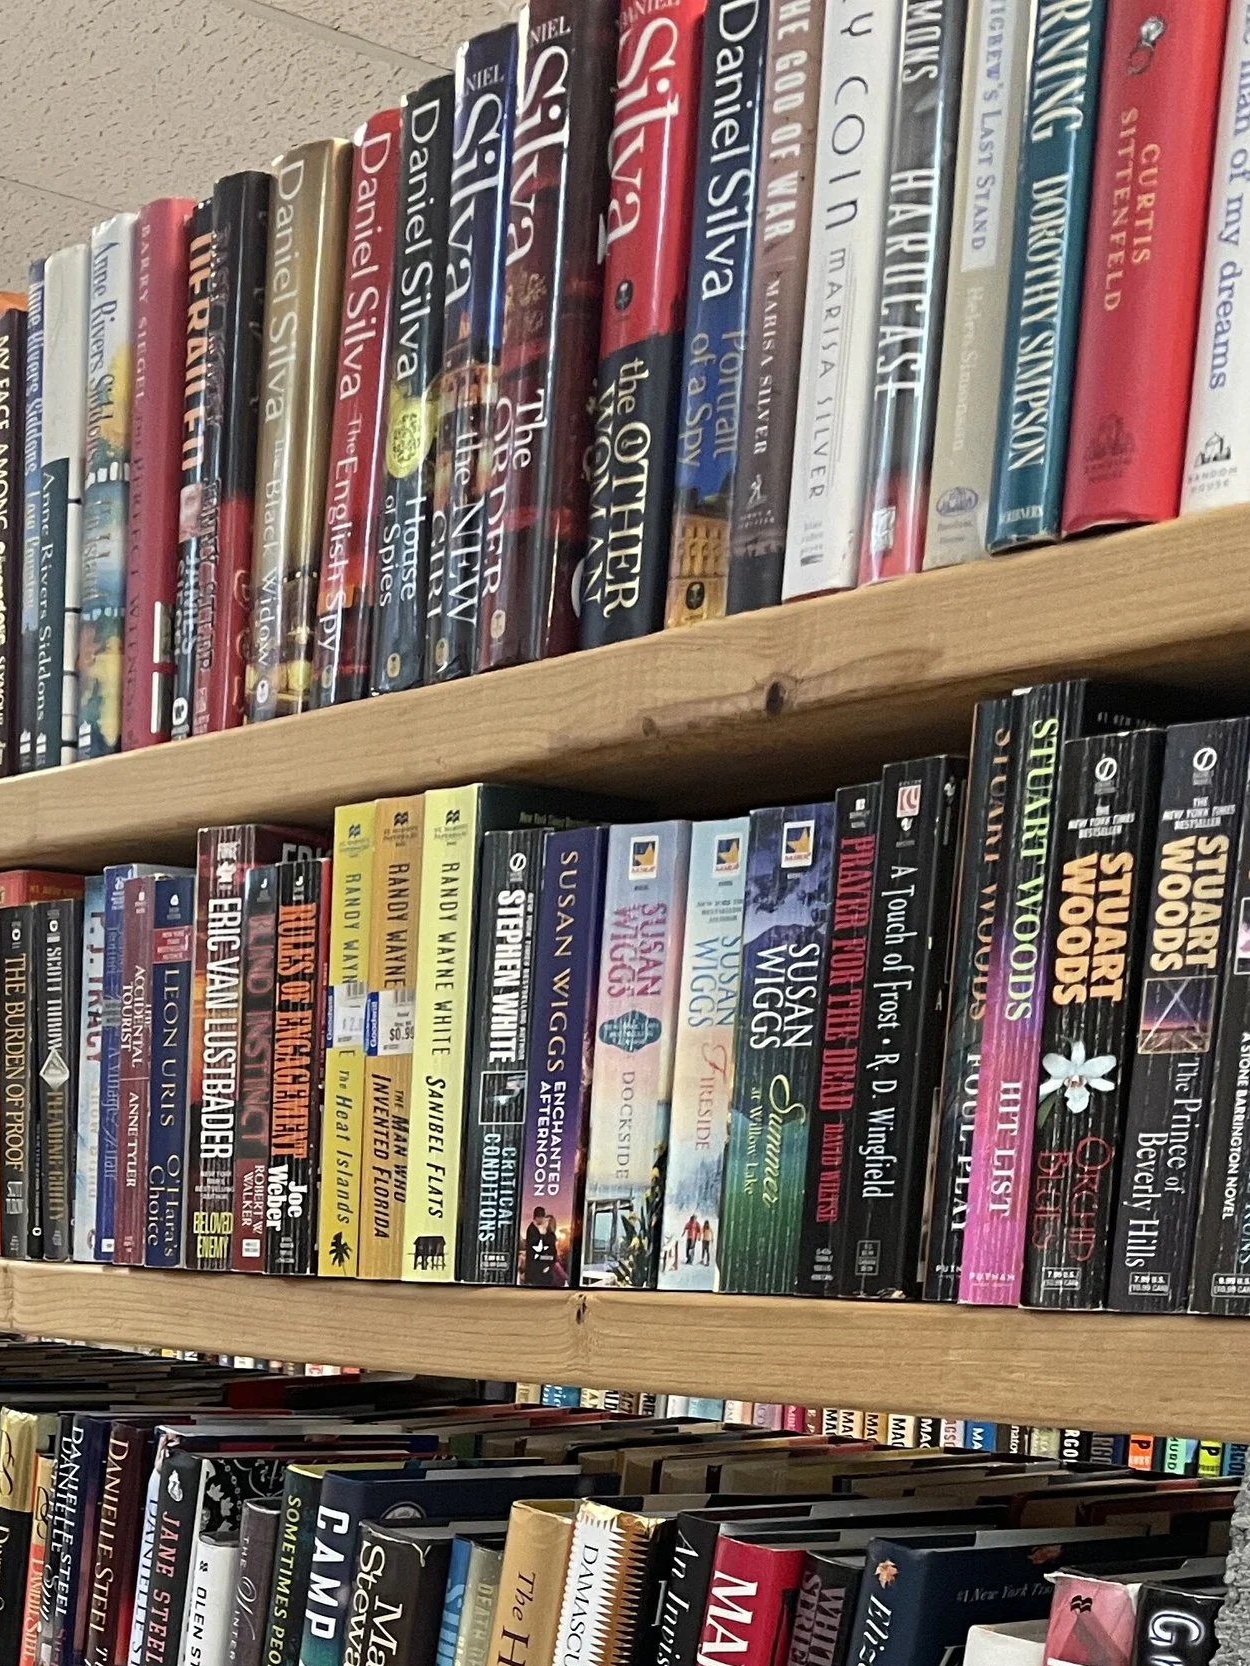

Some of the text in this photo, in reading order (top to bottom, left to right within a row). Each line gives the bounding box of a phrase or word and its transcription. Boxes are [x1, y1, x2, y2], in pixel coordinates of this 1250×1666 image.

[607, 16, 682, 245] Silva
[700, 0, 758, 301] Daniel Silva
[762, 49, 808, 245] GOD OF WAR
[1132, 142, 1161, 266] CURTIS
[339, 130, 393, 400] Daniel Silva
[396, 98, 441, 381] Daniel Silva
[1103, 107, 1140, 312] SITTENFELD
[1008, 173, 1070, 471] DOROTHY SIMPSON
[1209, 260, 1241, 392] dreams
[320, 455, 360, 654] English Spy
[603, 357, 652, 617] the OTHER
[1004, 718, 1059, 1024] STUART WOODS
[1052, 852, 1101, 1006] WOODS
[1092, 852, 1135, 1008] STUART
[199, 898, 242, 1159] ERIC VAN LUSTBADER
[424, 861, 460, 1219] RANDY WAYNE WHITE SANIBEL FLATS
[544, 850, 579, 1074] SUSAN WIGGS
[750, 944, 788, 1050] WIGGS
[783, 942, 821, 1049] SUSAN
[4, 954, 27, 1173] THE BURDEN OF PROOF
[160, 969, 180, 1127] LEON URIS
[615, 1071, 635, 1180] DOCKSIDE
[534, 1081, 553, 1197] AFTERNOON
[547, 1081, 567, 1197] ENCHANTED
[859, 1106, 896, 1200] Wingfield
[988, 1078, 1020, 1219] HIT LIST
[156, 1511, 181, 1575] JANE
[193, 1586, 210, 1640] OLEN
[302, 1506, 352, 1641] CAMP
[510, 1572, 538, 1624] The
